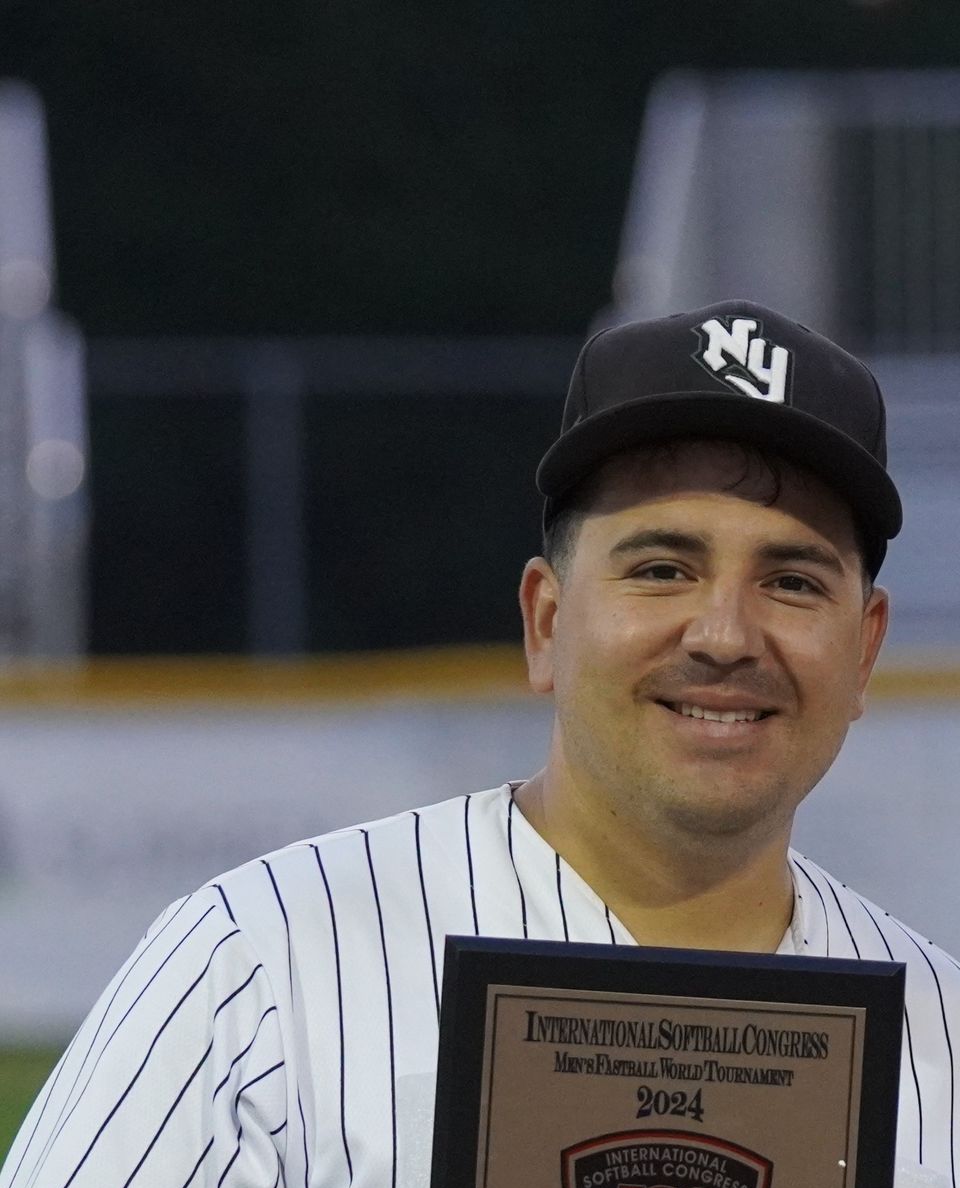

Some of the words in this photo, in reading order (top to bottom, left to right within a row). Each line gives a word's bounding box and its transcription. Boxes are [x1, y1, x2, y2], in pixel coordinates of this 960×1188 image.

[699, 317, 789, 405] NY
[523, 1010, 658, 1049] INTERNATIONAL
[658, 1018, 741, 1055] SOFTBALL
[742, 1023, 830, 1060] CONGRESS
[553, 1051, 595, 1074] MEN'S
[595, 1053, 659, 1079] FASTBALL
[659, 1057, 703, 1081] WORLD
[703, 1059, 795, 1087] TOURNAMENT
[635, 1084, 705, 1123] 2024
[605, 1146, 728, 1174] INTERNATIONAL
